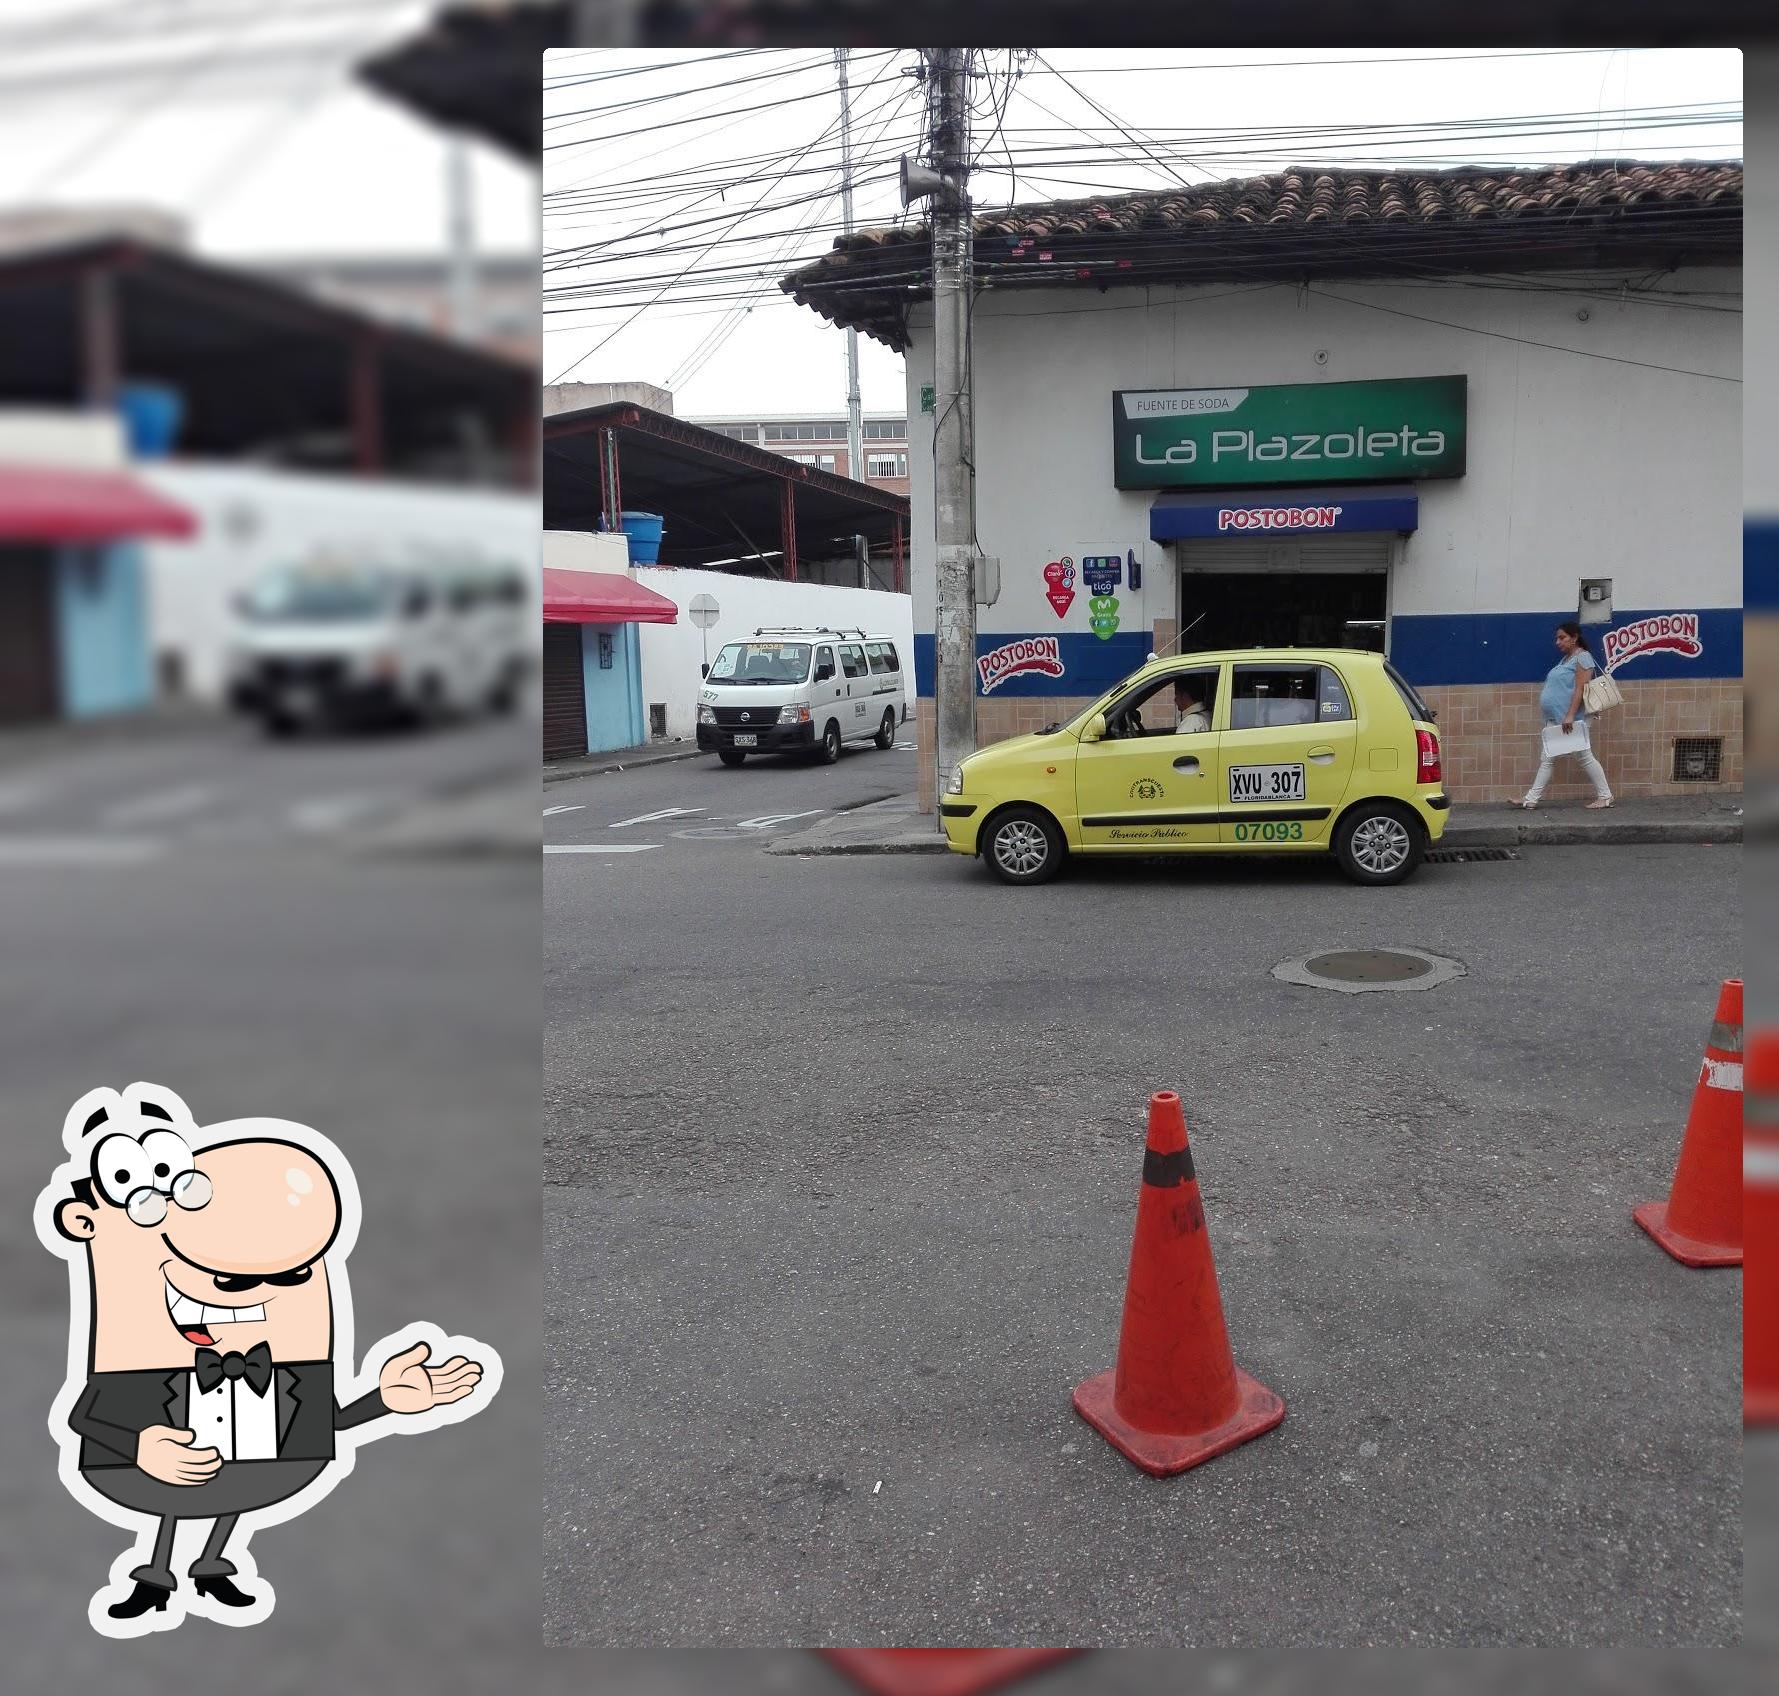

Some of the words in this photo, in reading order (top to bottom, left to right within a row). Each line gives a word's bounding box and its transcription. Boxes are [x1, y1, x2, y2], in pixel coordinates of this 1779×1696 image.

[1137, 400, 1177, 411] FUENTE
[1181, 399, 1195, 410] DE
[1198, 398, 1230, 409] SODA
[1135, 434, 1197, 465] La
[1212, 424, 1446, 463] Plazoleta
[1605, 614, 1697, 658] POSTOBON
[978, 638, 1058, 682] POSTOBON
[703, 690, 719, 702] 577
[1233, 773, 1262, 795] XVU
[1271, 771, 1301, 794] 307
[1109, 829, 1150, 839] Servicio
[1235, 822, 1303, 841] 07093
